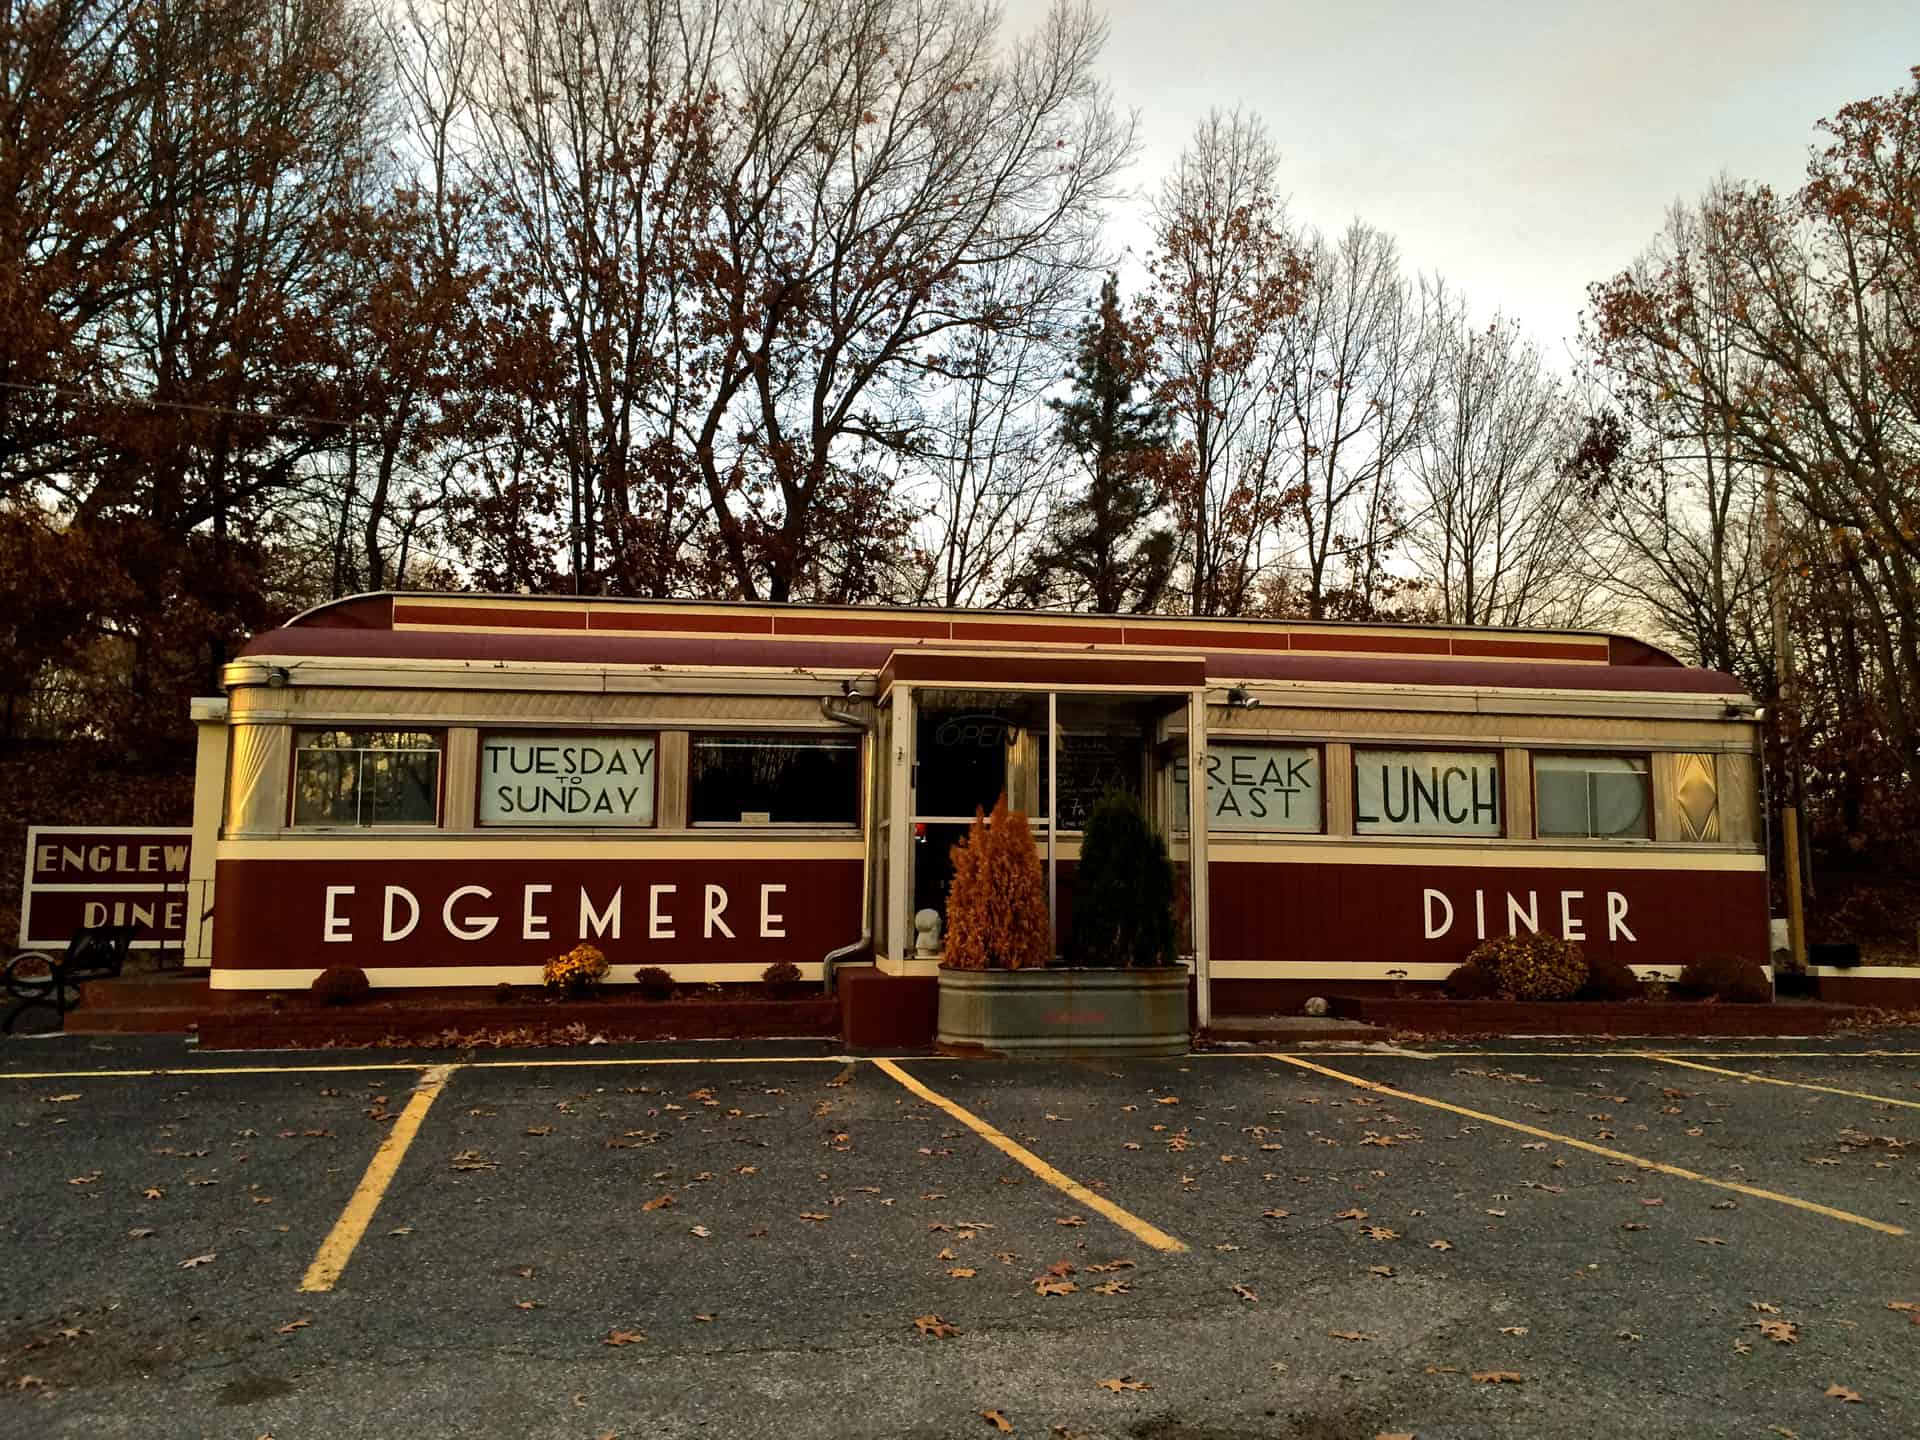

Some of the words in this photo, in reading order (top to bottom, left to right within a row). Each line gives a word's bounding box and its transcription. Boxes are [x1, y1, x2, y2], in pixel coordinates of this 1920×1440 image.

[941, 723, 1017, 747] OPEN
[485, 747, 654, 775] TUESDAY
[556, 776, 583, 785] TO
[1355, 764, 1497, 824] LUNCH
[498, 786, 639, 814] SUNDAY
[1187, 786, 1300, 818] AST
[83, 902, 184, 929] DINE
[323, 883, 787, 943] EDGEMERE
[1423, 888, 1638, 942] DINER
